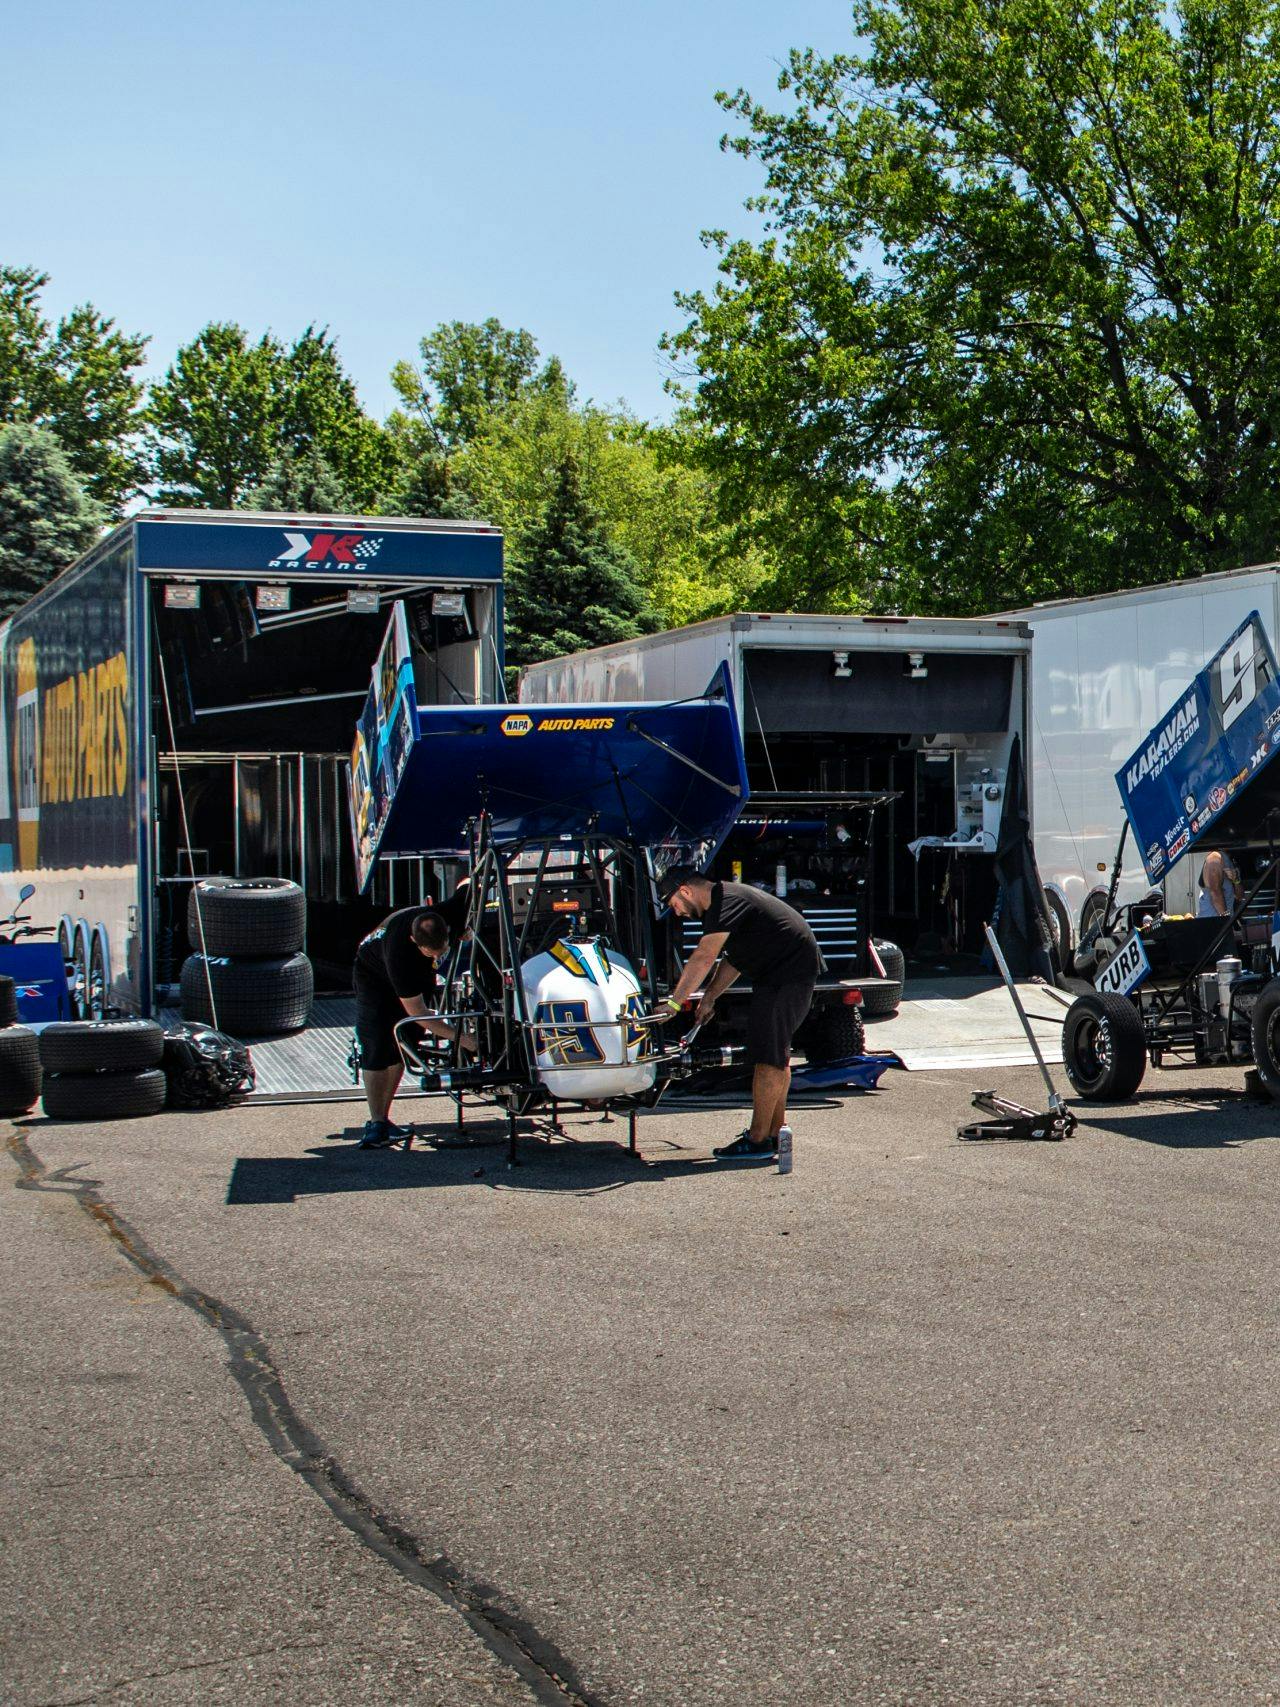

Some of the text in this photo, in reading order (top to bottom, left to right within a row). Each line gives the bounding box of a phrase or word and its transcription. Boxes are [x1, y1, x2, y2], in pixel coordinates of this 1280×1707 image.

[42, 651, 128, 804] AUTO PARTS
[506, 720, 528, 731] NAPA
[538, 718, 615, 731] AUTO PARTS
[1126, 693, 1198, 794] KARAVAN
[1100, 940, 1140, 993] CURB
